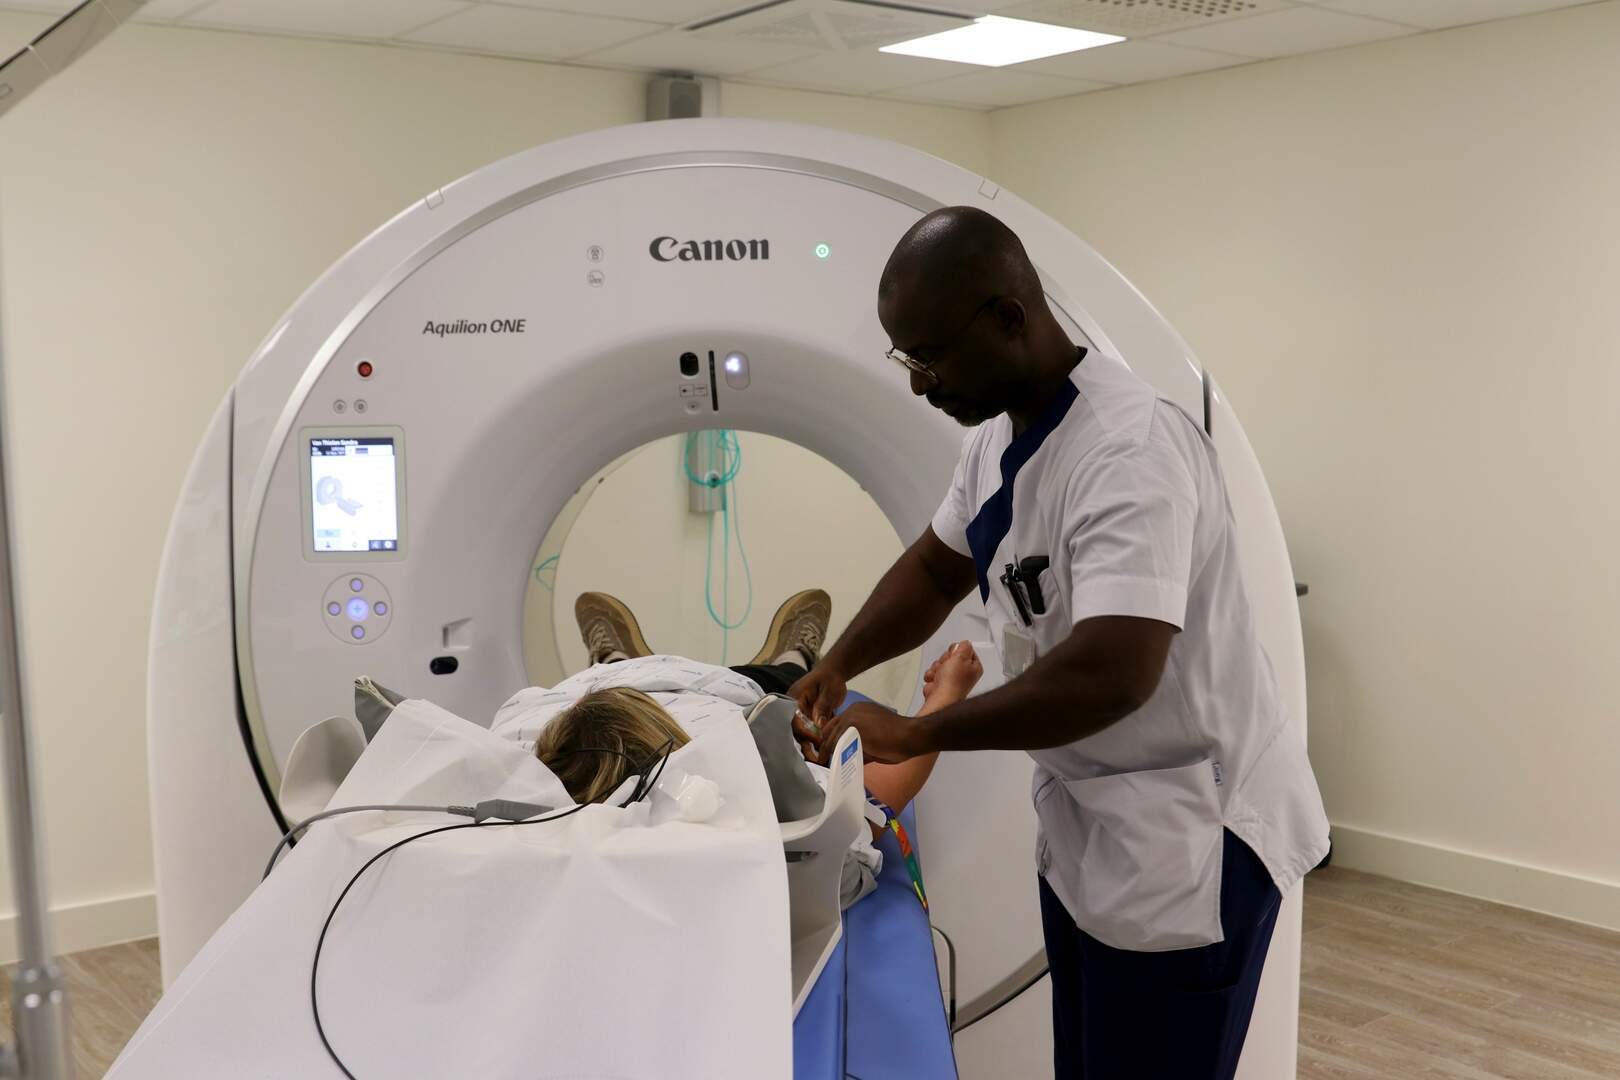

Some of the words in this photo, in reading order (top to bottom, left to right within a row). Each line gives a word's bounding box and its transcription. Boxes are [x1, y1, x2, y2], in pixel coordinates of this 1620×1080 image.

[649, 236, 769, 262] Canon
[422, 319, 487, 338] Aquilion
[489, 318, 527, 333] ONE
